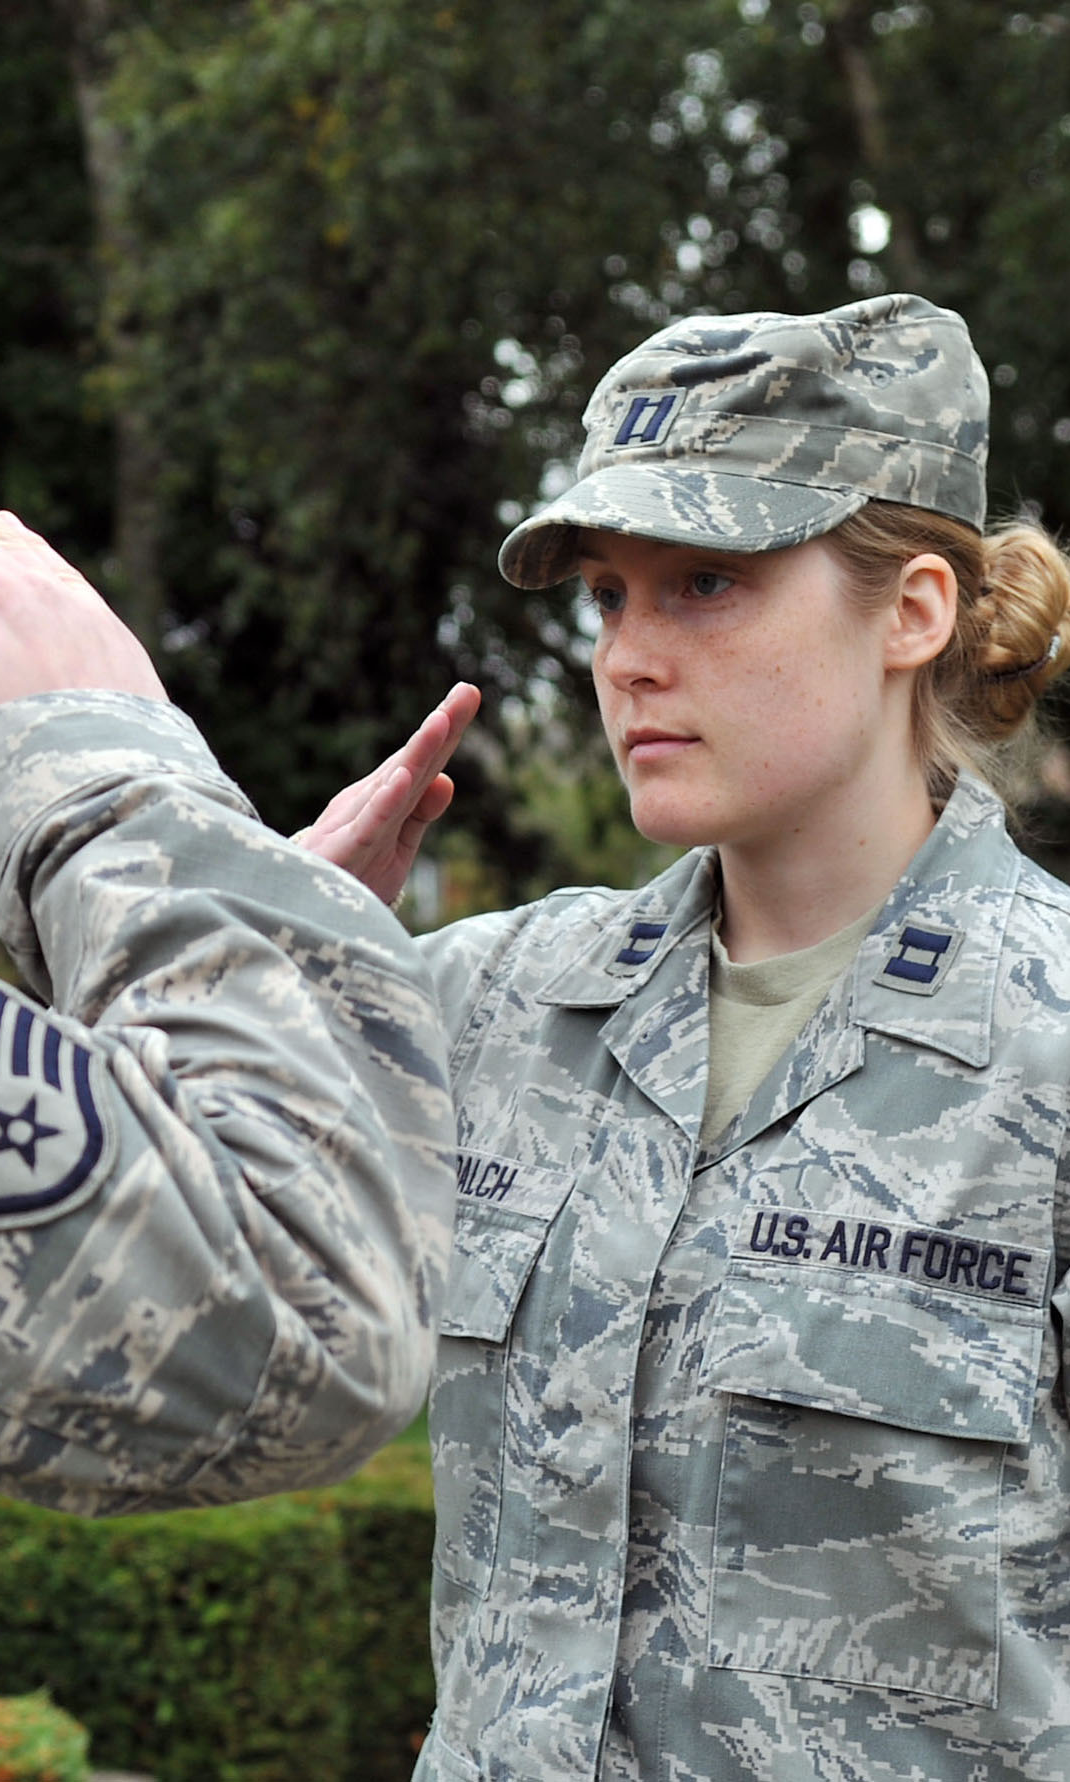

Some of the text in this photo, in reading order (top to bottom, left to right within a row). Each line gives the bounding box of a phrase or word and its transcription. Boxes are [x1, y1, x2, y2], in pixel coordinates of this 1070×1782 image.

[749, 1211, 1032, 1295] U.S. AIR FORCE
